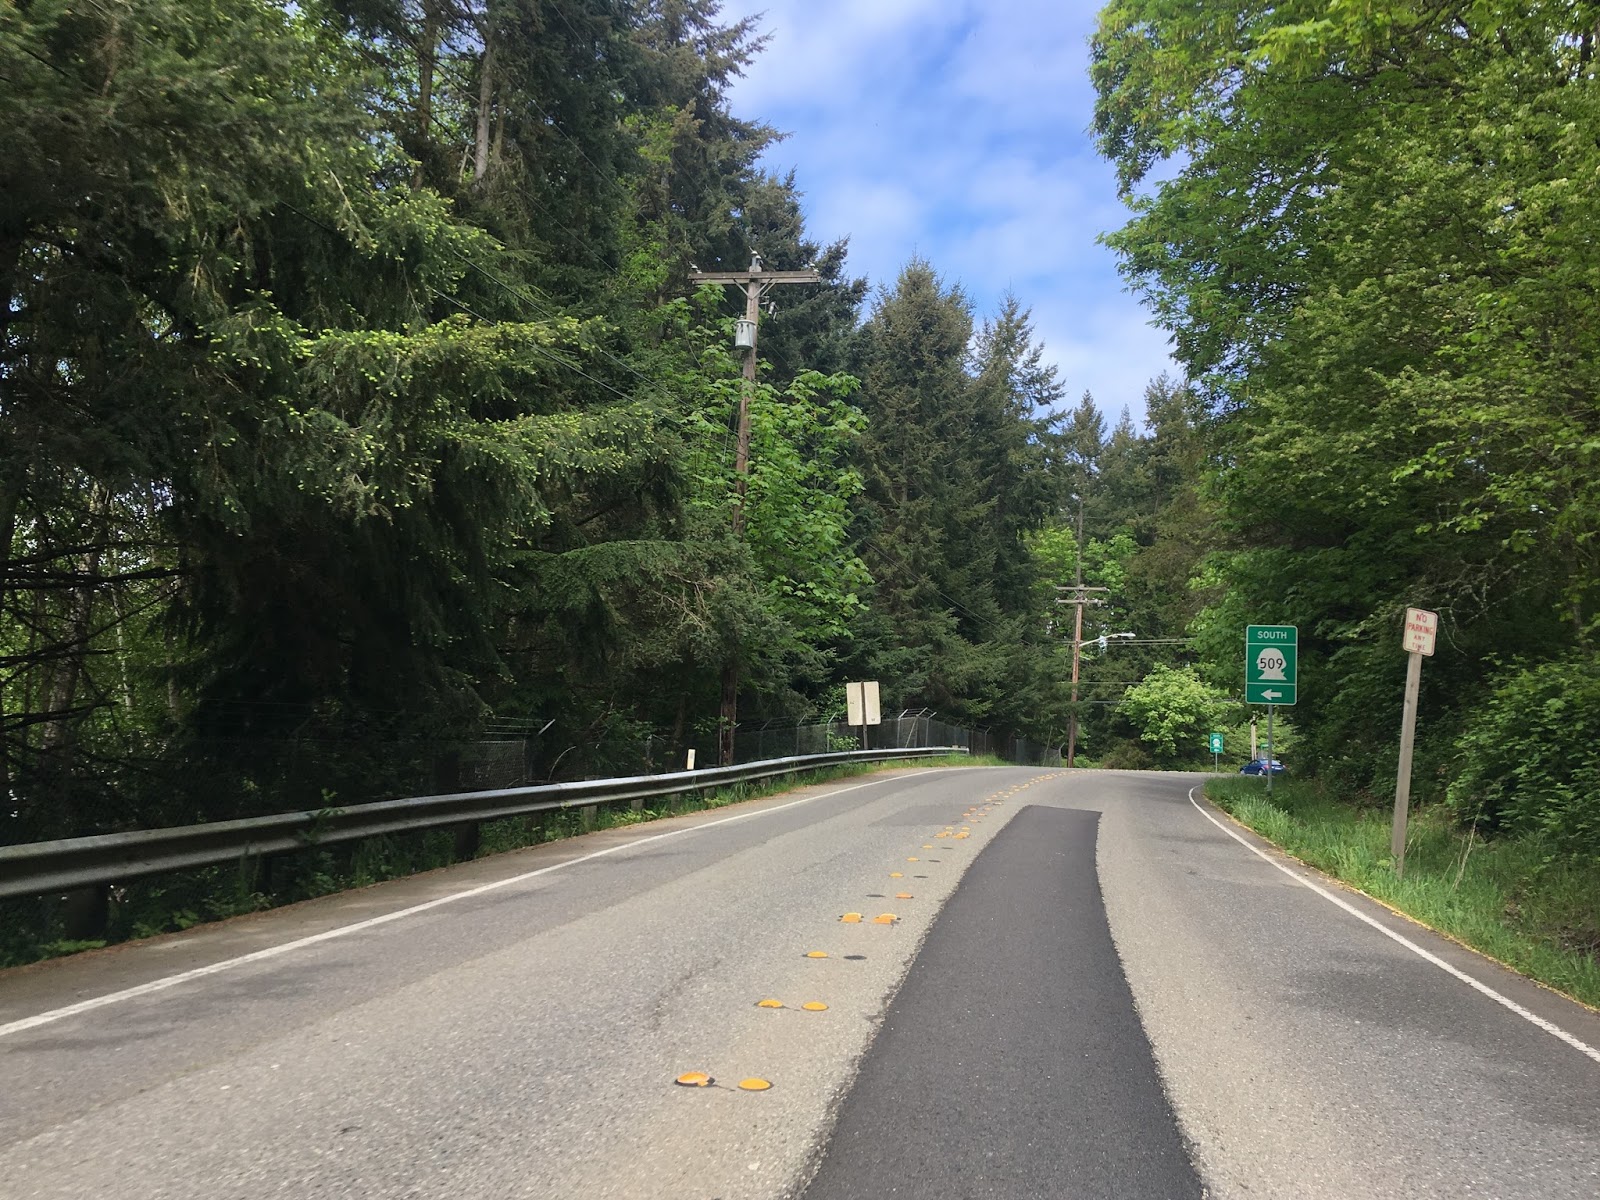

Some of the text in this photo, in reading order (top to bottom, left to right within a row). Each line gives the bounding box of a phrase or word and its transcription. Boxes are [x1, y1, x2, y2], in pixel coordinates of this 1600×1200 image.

[1415, 613, 1428, 623] NO
[1407, 622, 1434, 635] PARKING
[1257, 630, 1287, 639] SOUTH
[1412, 642, 1426, 650] TIME
[1260, 657, 1283, 669] 509
